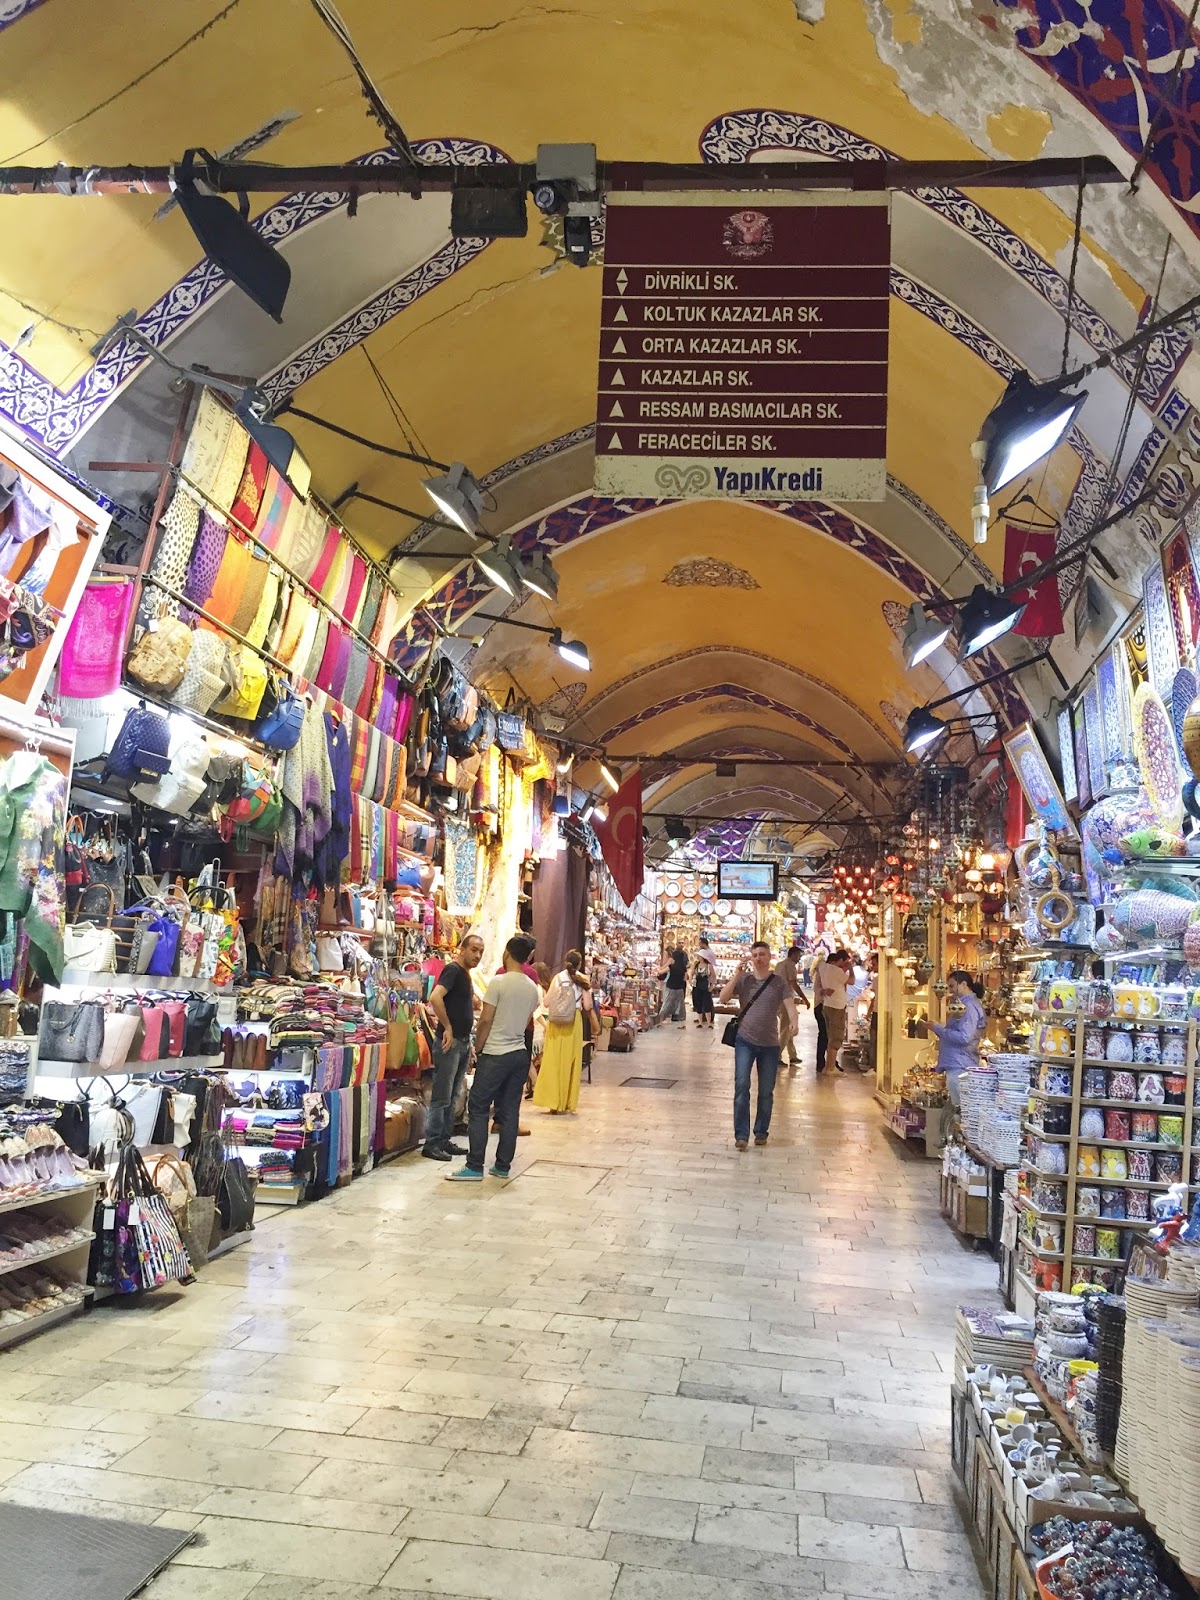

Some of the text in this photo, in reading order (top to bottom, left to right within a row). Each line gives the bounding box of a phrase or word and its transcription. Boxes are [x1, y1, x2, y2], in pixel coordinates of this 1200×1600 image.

[645, 271, 739, 290] DİVRİKLİ SK.
[643, 306, 823, 322] KOLTUK KAZAZLAR SK.
[642, 338, 802, 354] ORTA KAZAZLAR SK.
[641, 370, 753, 386] KAZAZLAR SK.
[639, 402, 842, 419] RESSAM BASMACILAR SK.
[638, 431, 777, 451] FERACECİLER SK.
[713, 466, 823, 492] YapıKredi
